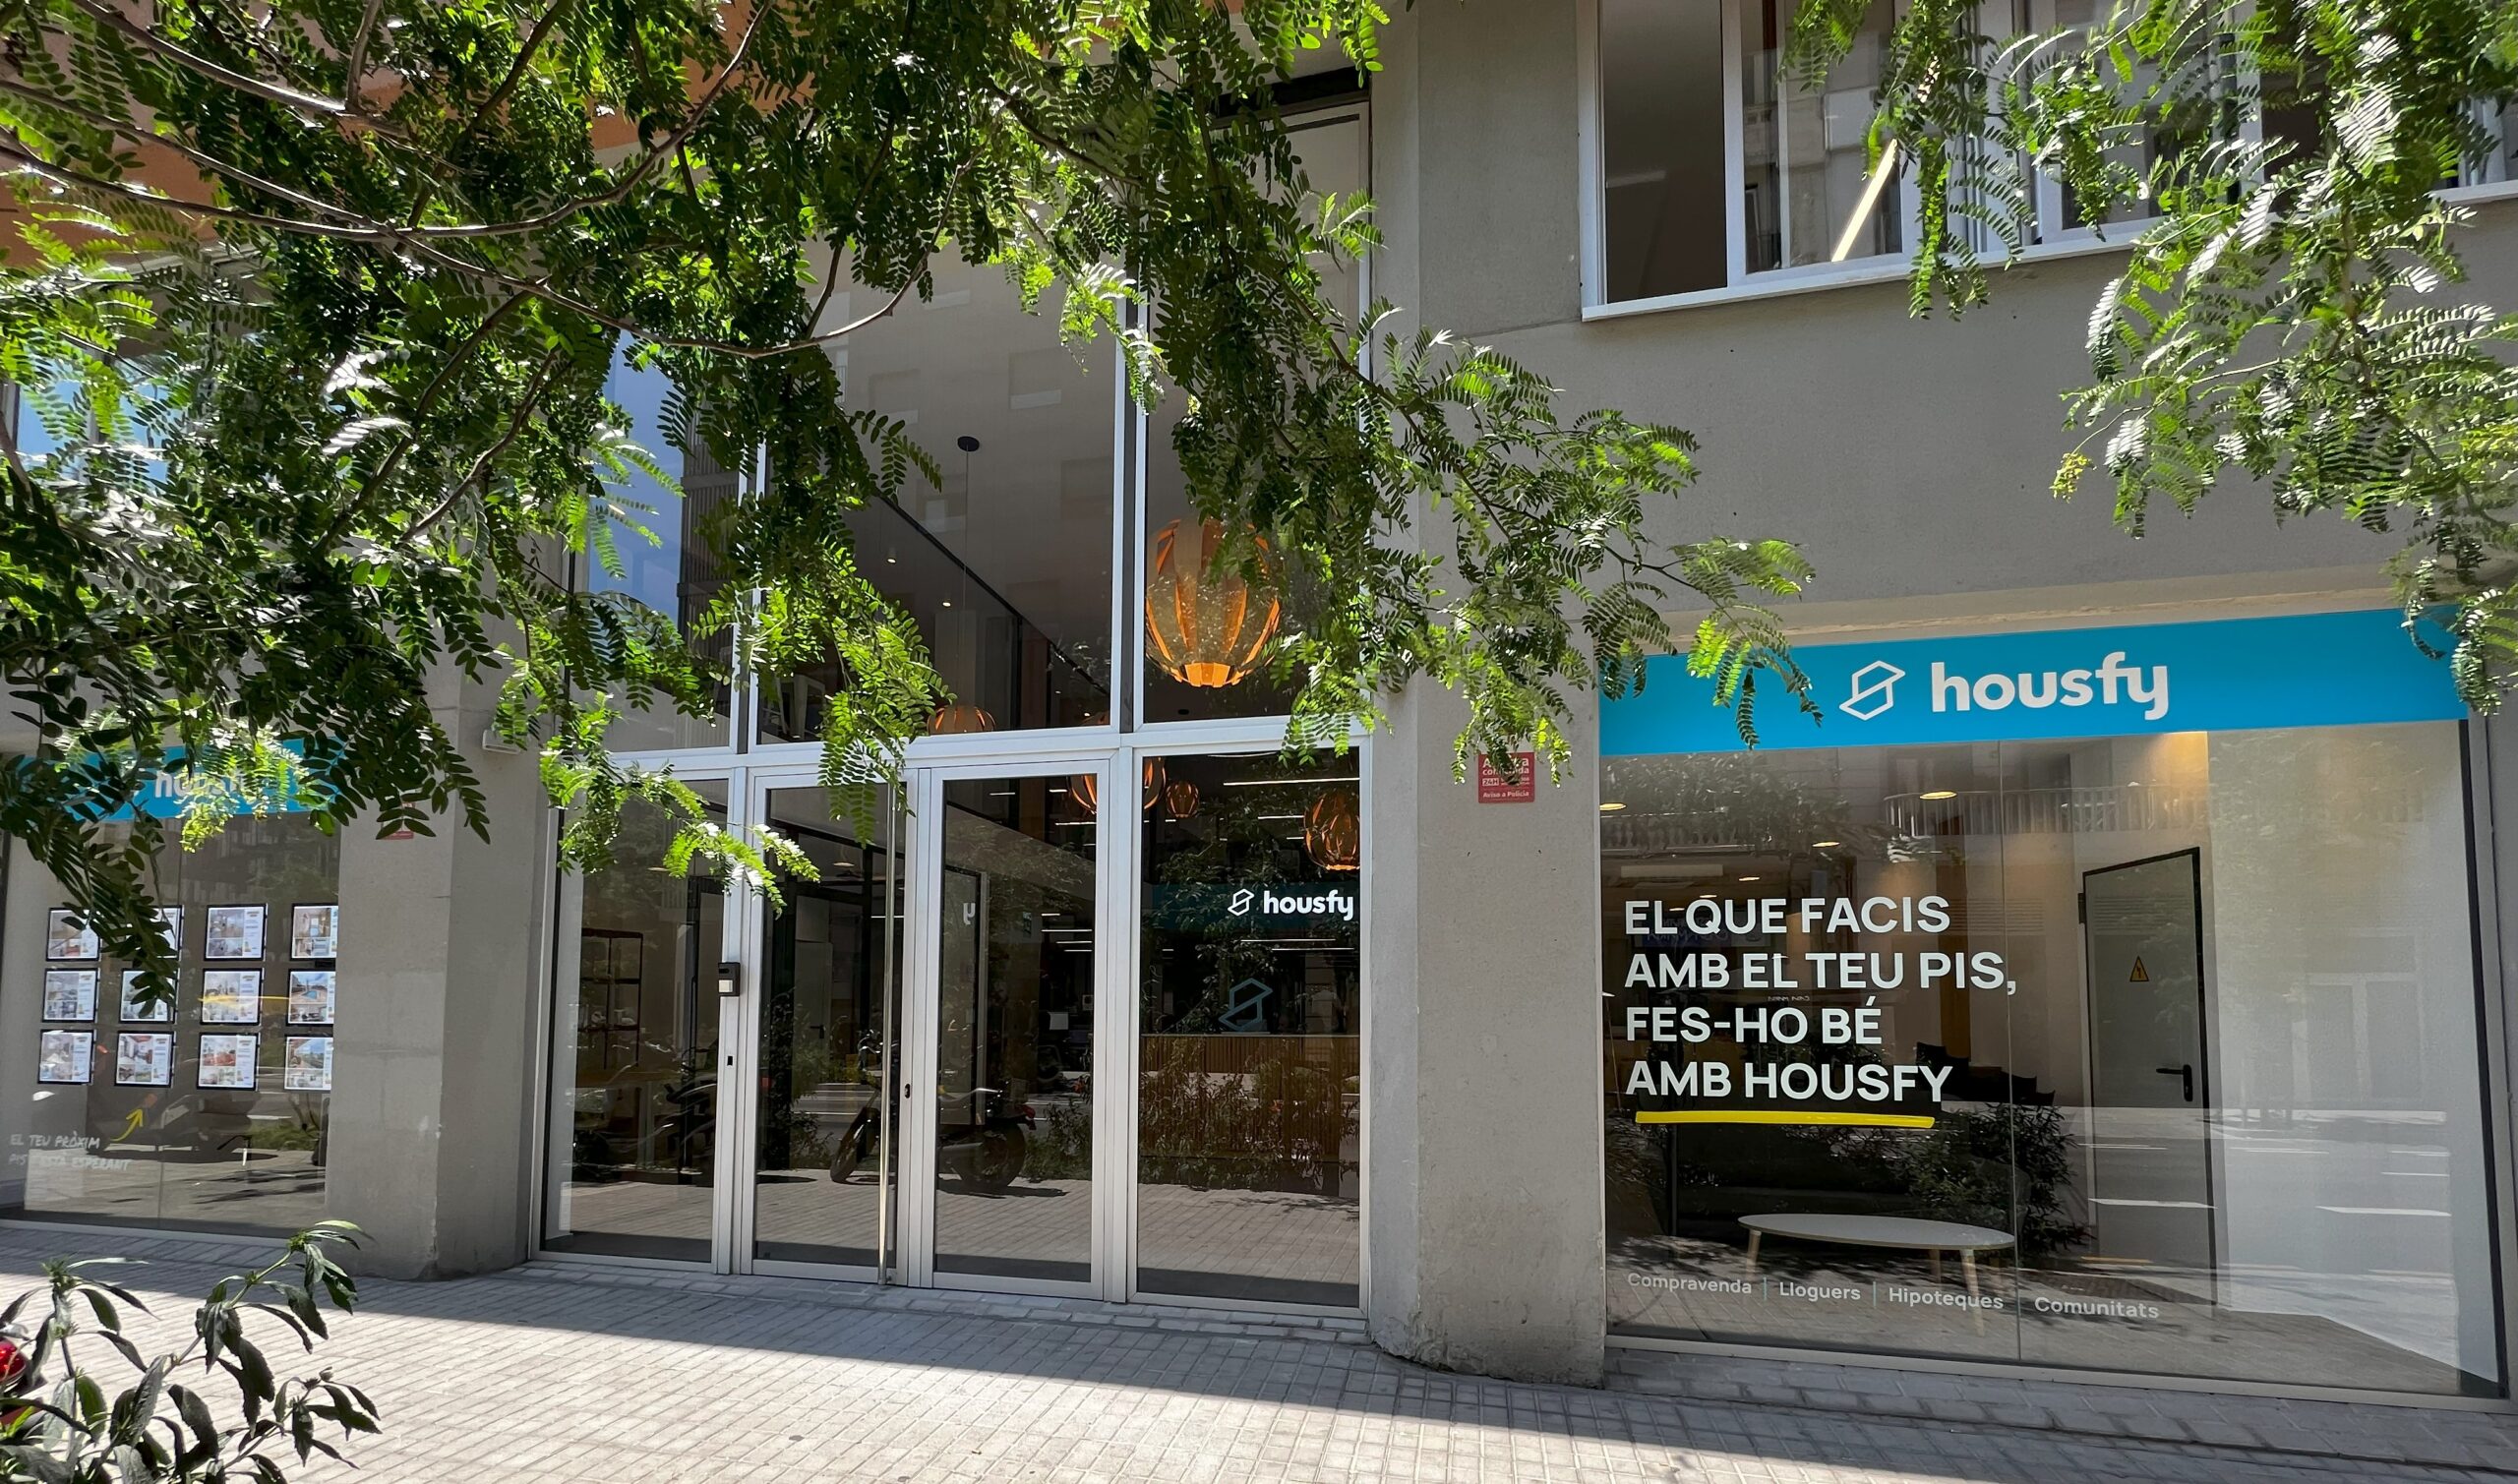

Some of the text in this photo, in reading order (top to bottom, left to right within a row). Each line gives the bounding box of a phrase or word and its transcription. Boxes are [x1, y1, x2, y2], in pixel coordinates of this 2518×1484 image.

[1931, 650, 2170, 721] housfy
[1263, 889, 1353, 921] housfy
[1625, 900, 1678, 935] EL
[1685, 898, 1787, 935] QUE
[1801, 896, 1951, 933] FACIS
[1624, 951, 2016, 996] AMB EL TEU PIS,
[1626, 995, 1883, 1044] FES-HO BÉ
[1625, 1060, 1953, 1102] AMB HOUSFY
[10, 1133, 24, 1146] EL
[29, 1134, 51, 1147] TEU
[1627, 1272, 2160, 1320] Compravenda Lloguers Hipoteques Comunitats
